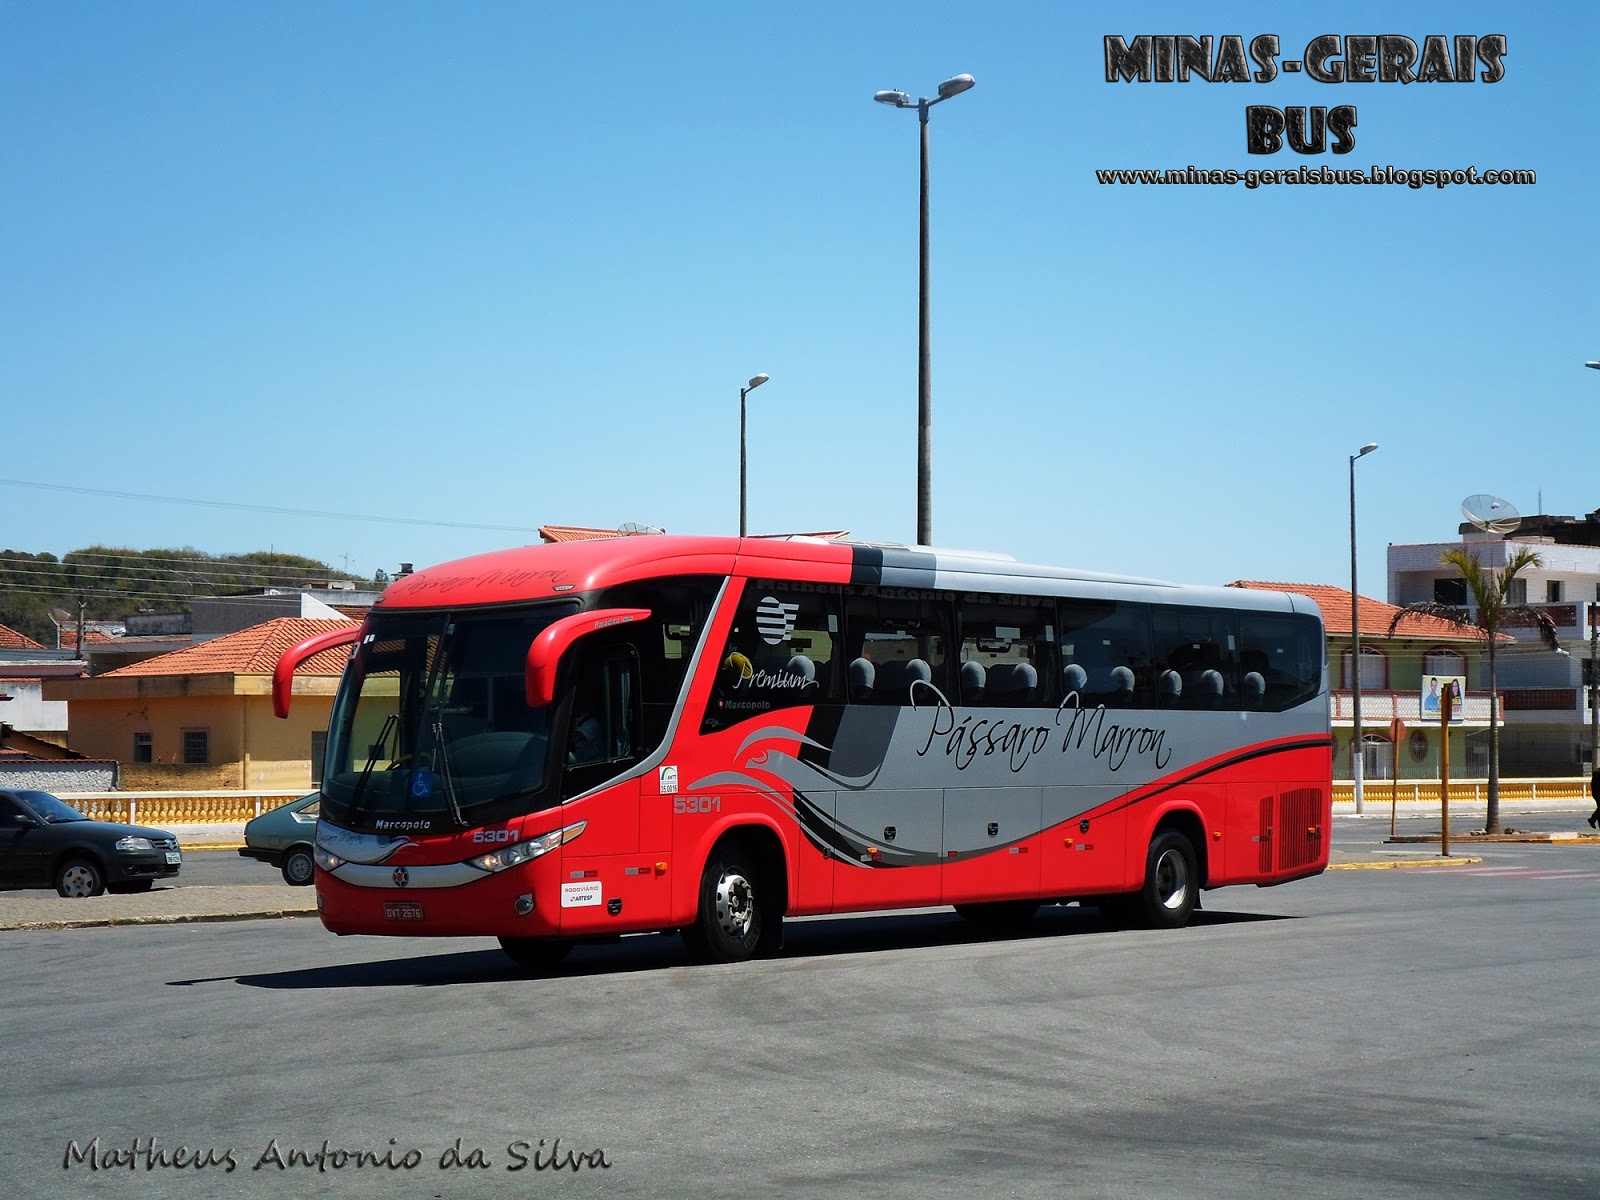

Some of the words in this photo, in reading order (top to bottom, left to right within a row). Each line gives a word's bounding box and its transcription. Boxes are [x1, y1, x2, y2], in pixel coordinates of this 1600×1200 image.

[722, 651, 820, 690] Premium
[725, 700, 771, 710] Marcopolo
[909, 679, 1051, 773] Pássaro
[1055, 691, 1172, 772] Marron
[673, 796, 721, 814] 5301
[375, 819, 431, 831] Marcopolo
[472, 829, 519, 843] 5301
